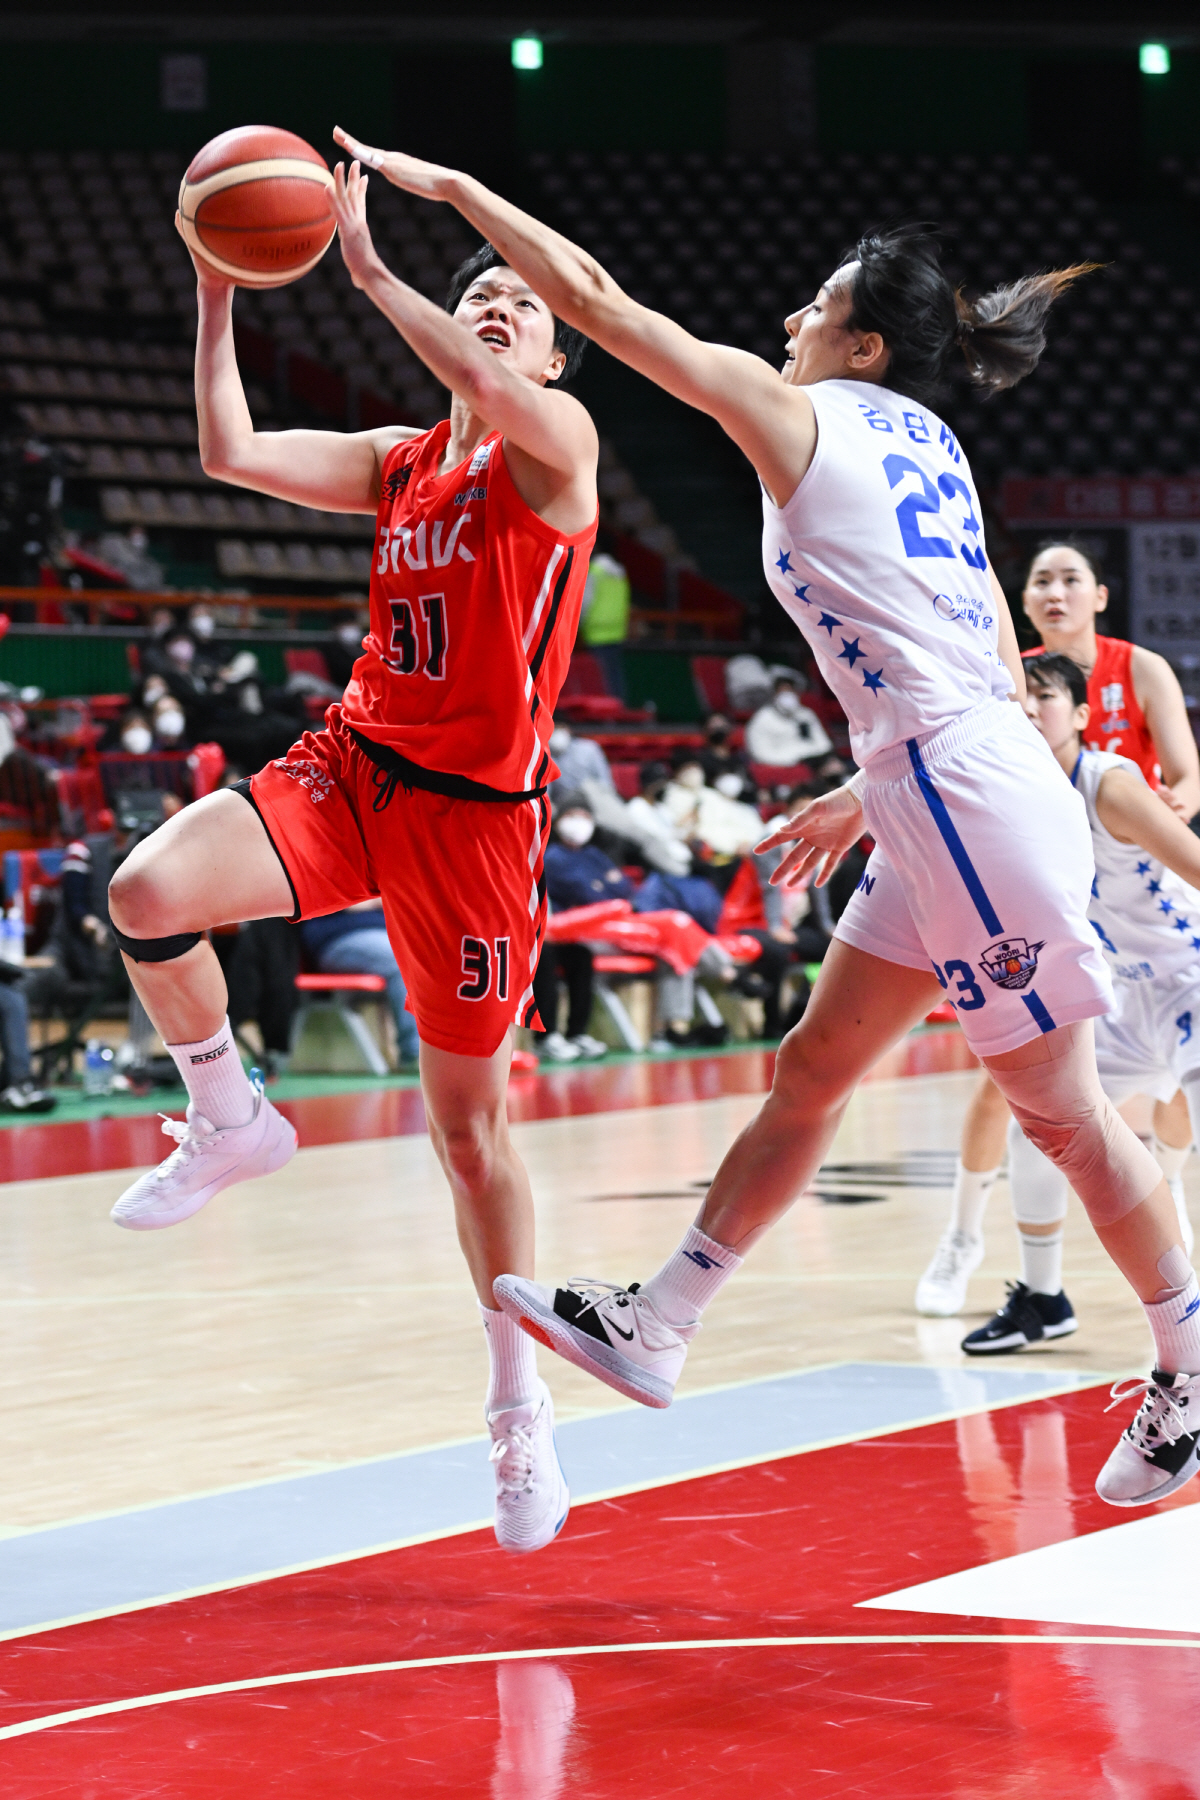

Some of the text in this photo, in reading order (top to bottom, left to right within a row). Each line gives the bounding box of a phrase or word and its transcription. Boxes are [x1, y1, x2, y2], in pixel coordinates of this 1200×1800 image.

[242, 240, 311, 260] molten
[376, 512, 476, 575] BNK
[881, 452, 988, 573] 23
[383, 591, 449, 681] 31
[456, 934, 511, 1003] 31
[994, 947, 1021, 961] WOORI
[191, 1043, 229, 1064] BNK
